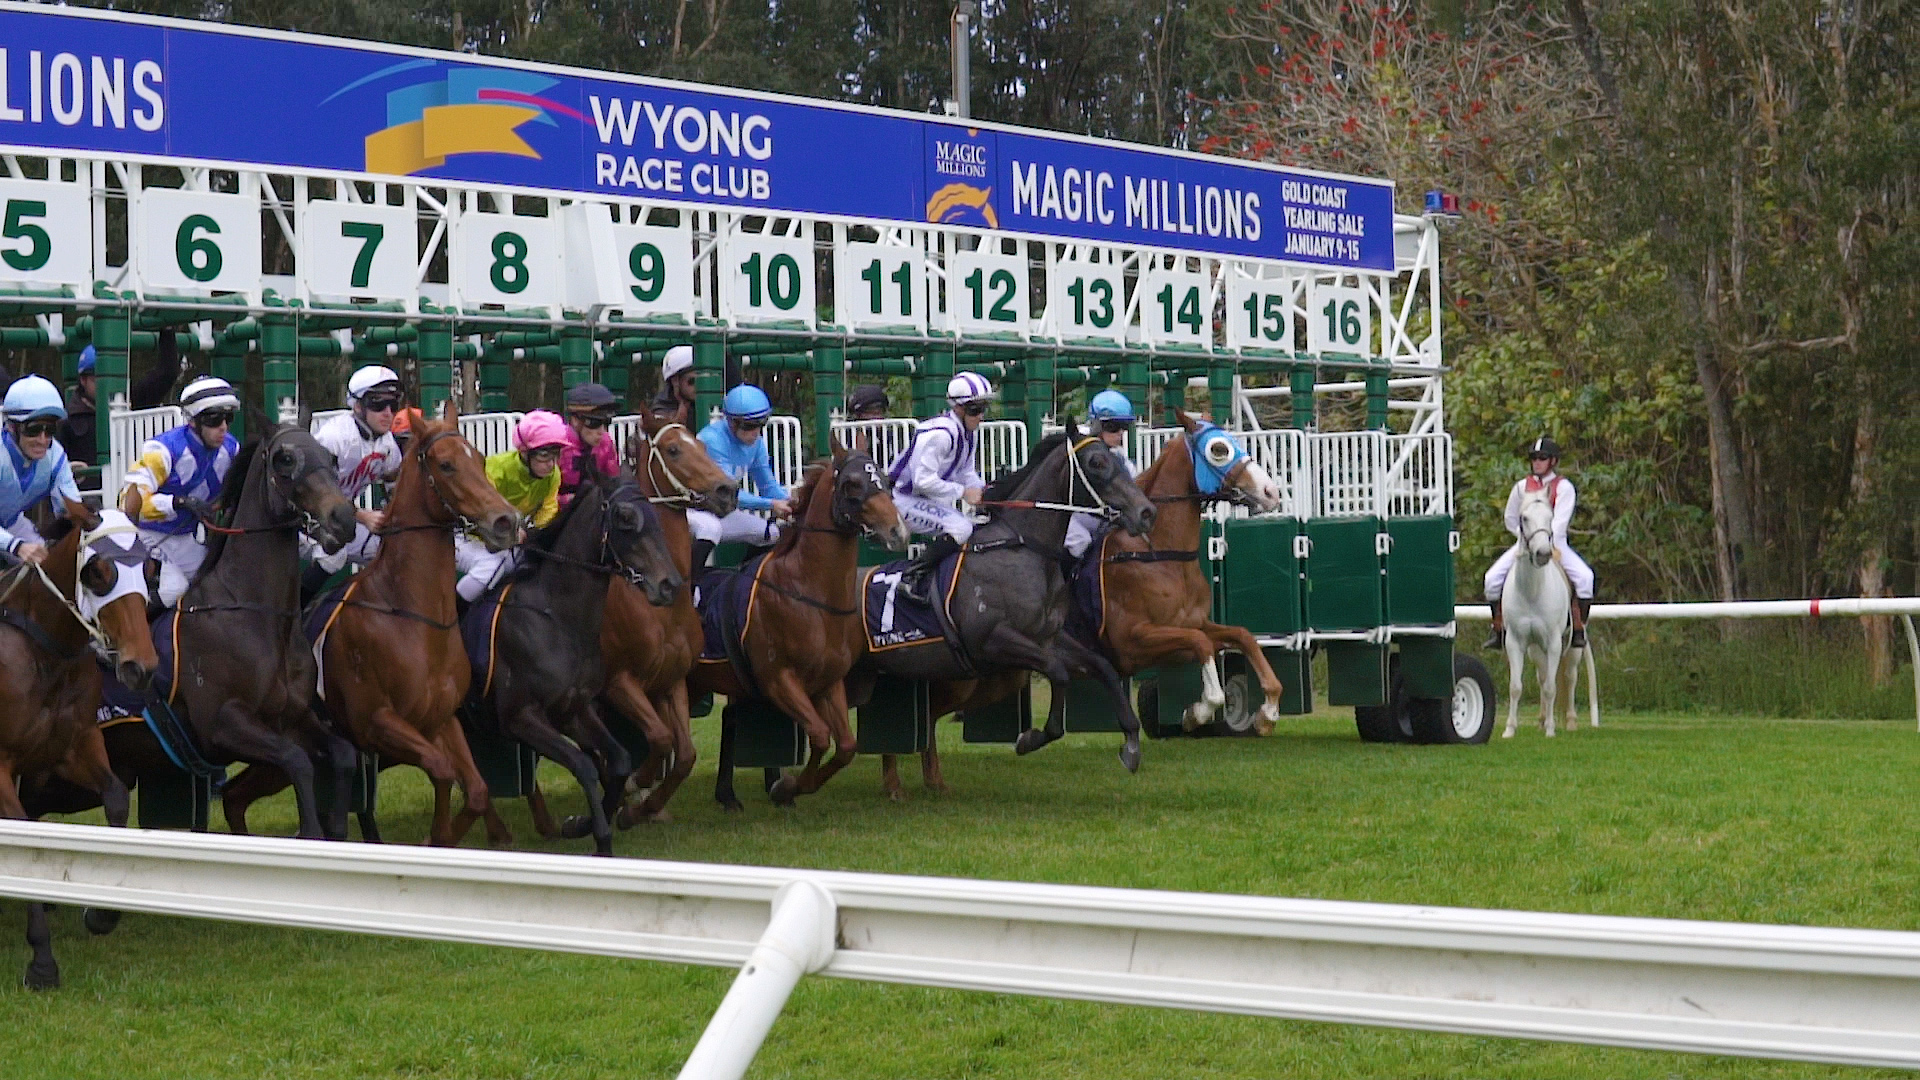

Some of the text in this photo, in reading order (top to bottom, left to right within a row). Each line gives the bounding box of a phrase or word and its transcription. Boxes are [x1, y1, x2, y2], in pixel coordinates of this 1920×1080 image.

[590, 96, 772, 161] WYONG
[936, 141, 986, 165] MAGIC
[596, 153, 771, 200] RACE CLUB
[936, 160, 986, 177] MILLIONS
[1282, 180, 1347, 209] GOLD COAST
[1012, 160, 1261, 242] MAGIC MILLIONS
[1283, 206, 1364, 236] YEARLING SALE
[2, 200, 51, 271] 5
[176, 214, 222, 282] 6
[342, 222, 384, 288] 7
[1285, 232, 1360, 260] JANUARY 9-15
[490, 232, 529, 294] 8
[629, 243, 665, 302] 9
[741, 253, 801, 311] 10
[861, 260, 911, 316] 11
[965, 268, 1017, 322] 12
[1067, 277, 1114, 328] 13
[1157, 284, 1203, 335] 14
[1244, 293, 1285, 341] 15
[1323, 300, 1361, 345] 16
[872, 571, 902, 633] 7
